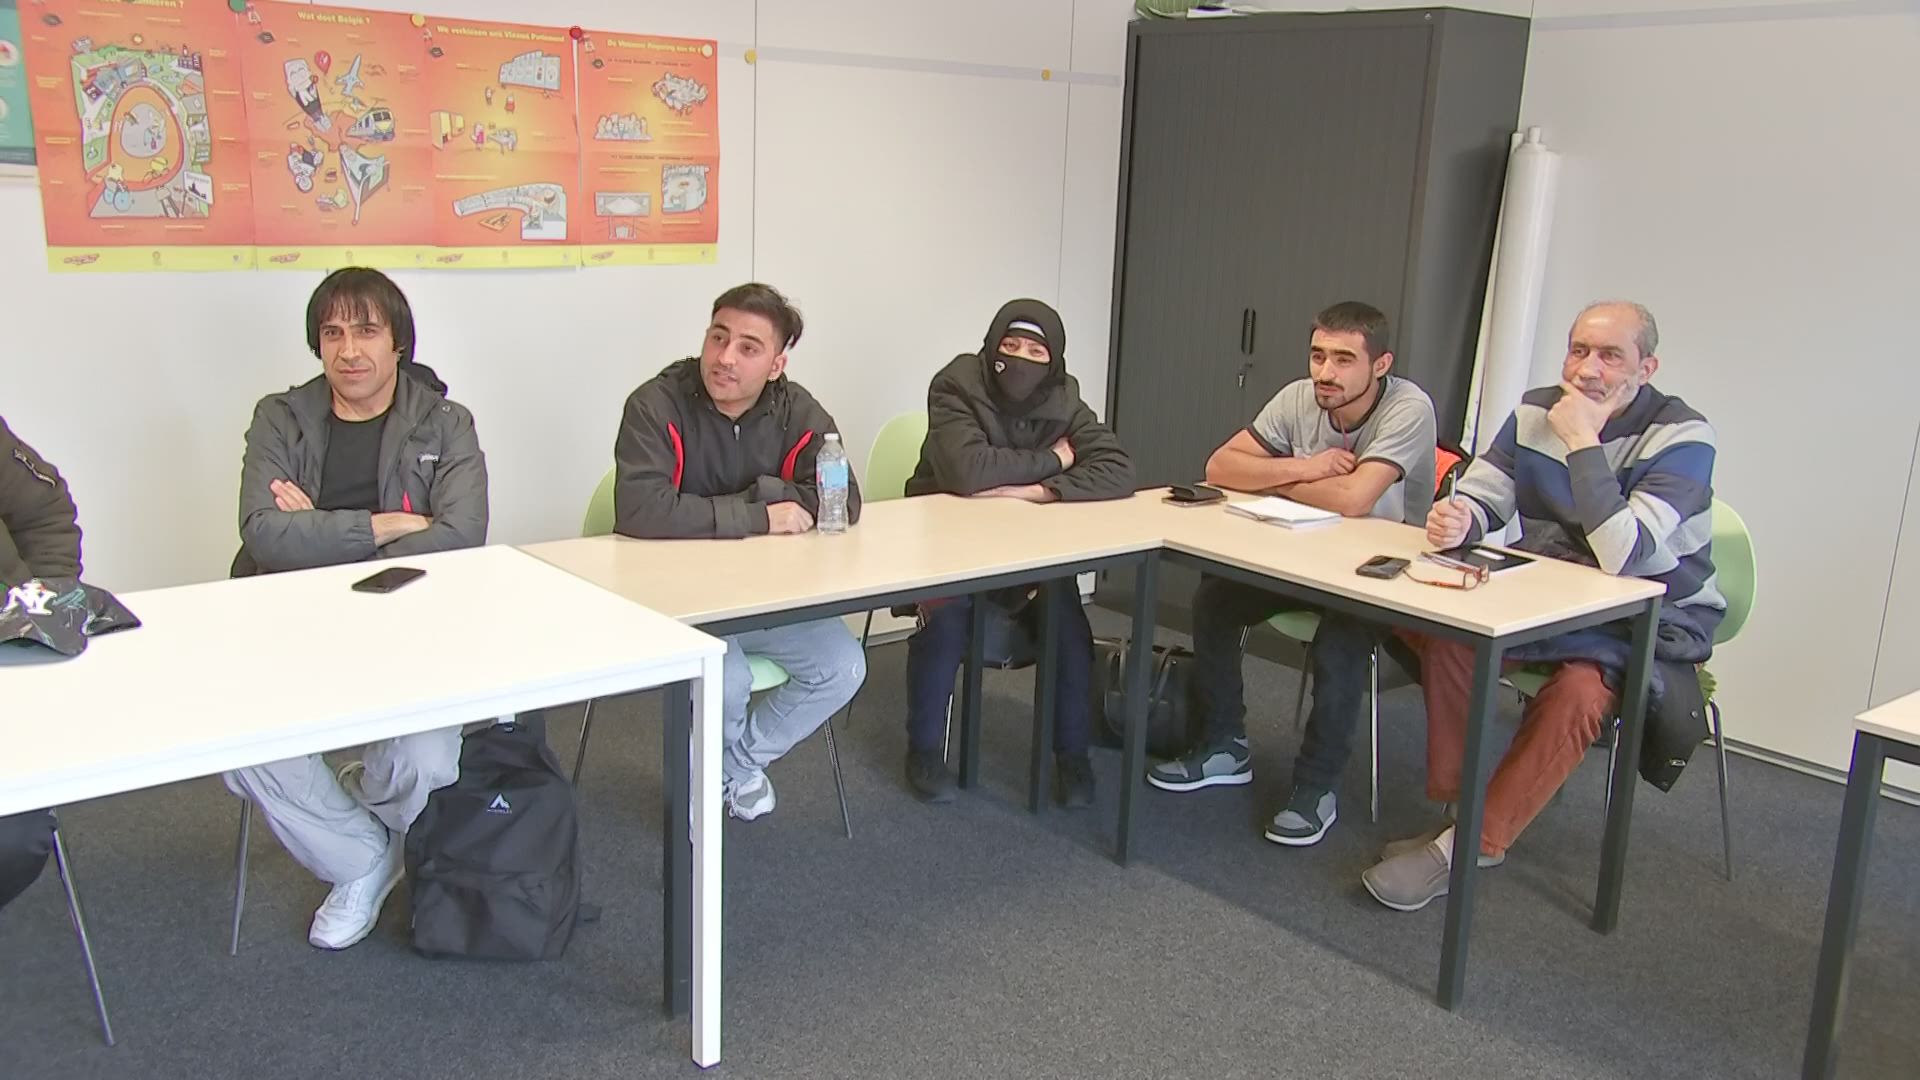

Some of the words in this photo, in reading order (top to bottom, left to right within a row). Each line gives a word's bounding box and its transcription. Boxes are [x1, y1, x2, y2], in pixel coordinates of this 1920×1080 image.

[297, 10, 314, 21] Wat
[437, 25, 448, 34] We
[3, 577, 57, 615] NY
